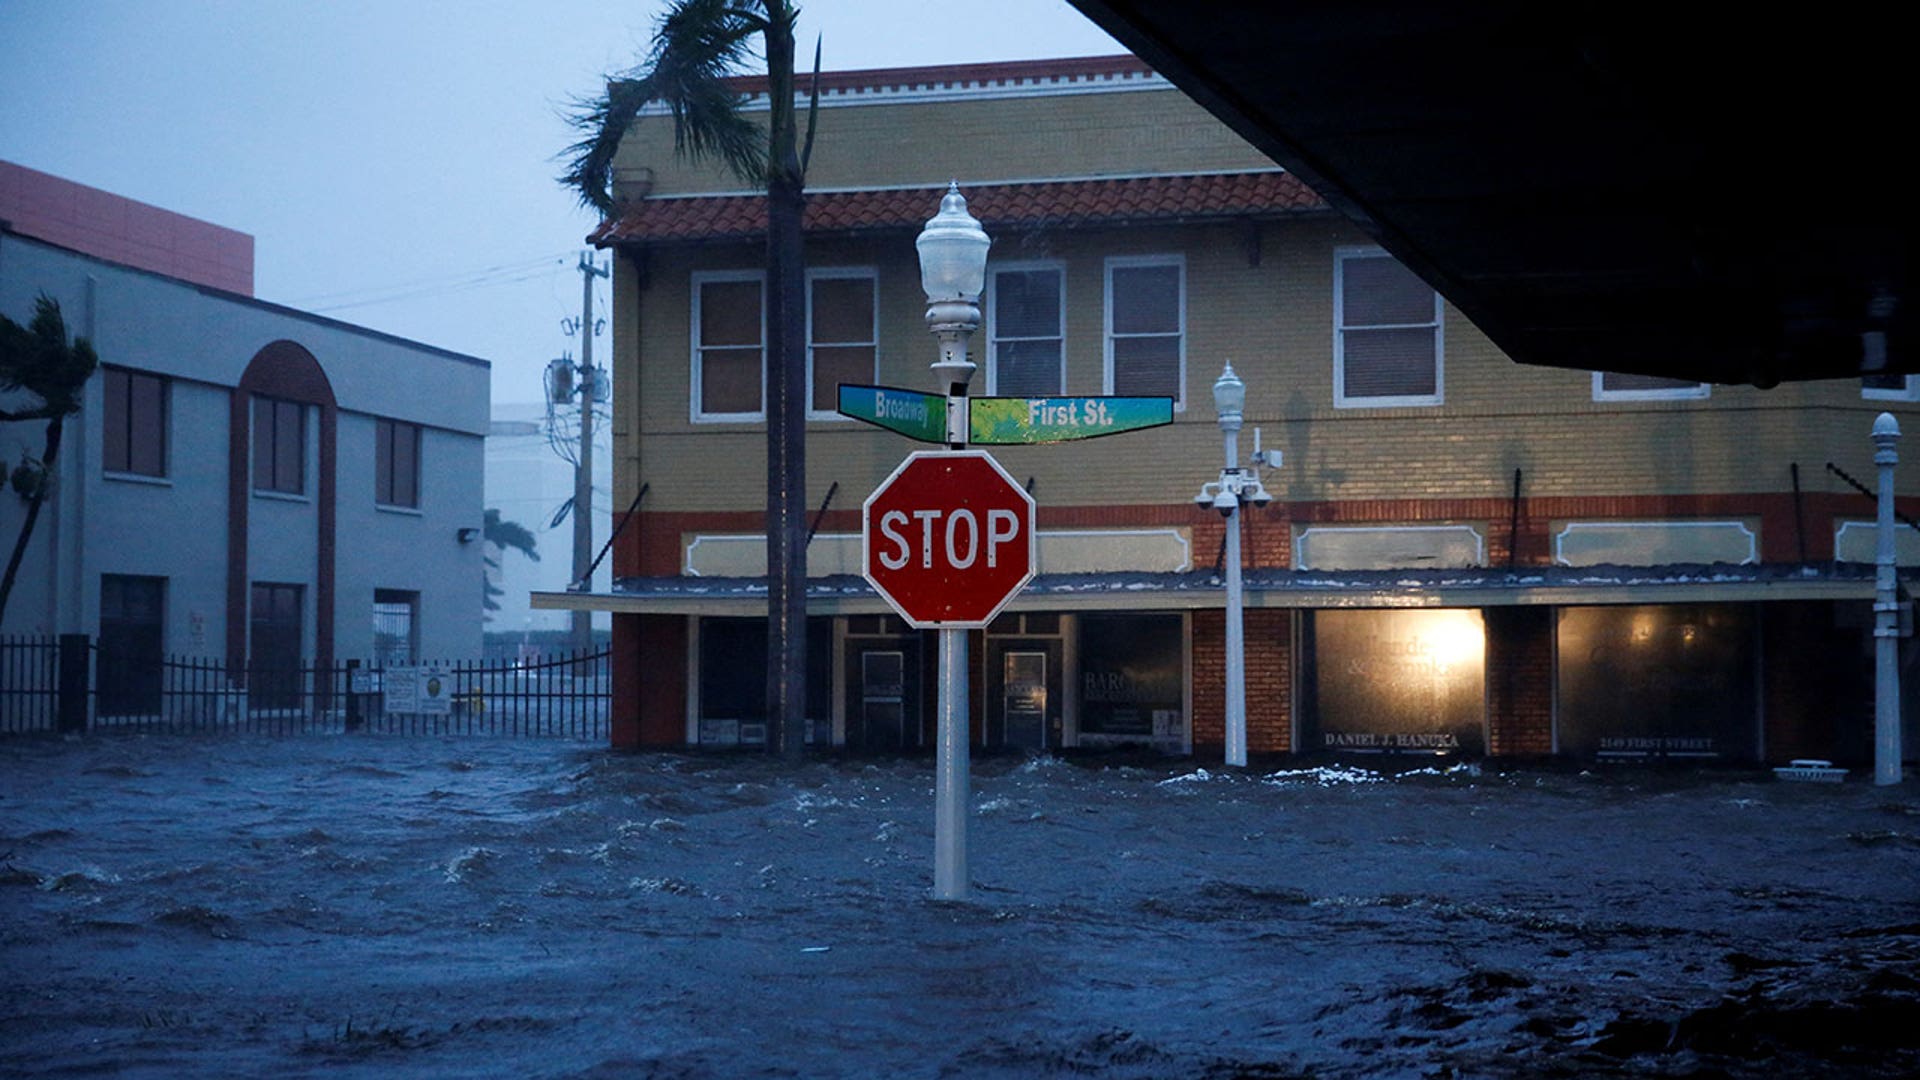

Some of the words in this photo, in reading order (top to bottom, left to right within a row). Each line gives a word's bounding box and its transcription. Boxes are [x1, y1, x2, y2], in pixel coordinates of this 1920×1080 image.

[875, 391, 929, 428] Broadway
[1028, 398, 1079, 426] First
[1083, 399, 1113, 426] St.
[878, 508, 1020, 570] STOP
[1325, 733, 1379, 745] DANIEL
[1382, 733, 1393, 746] J.
[1396, 733, 1460, 746] HANUKA
[1627, 737, 1662, 748] FIRST
[1665, 737, 1713, 749] STREET
